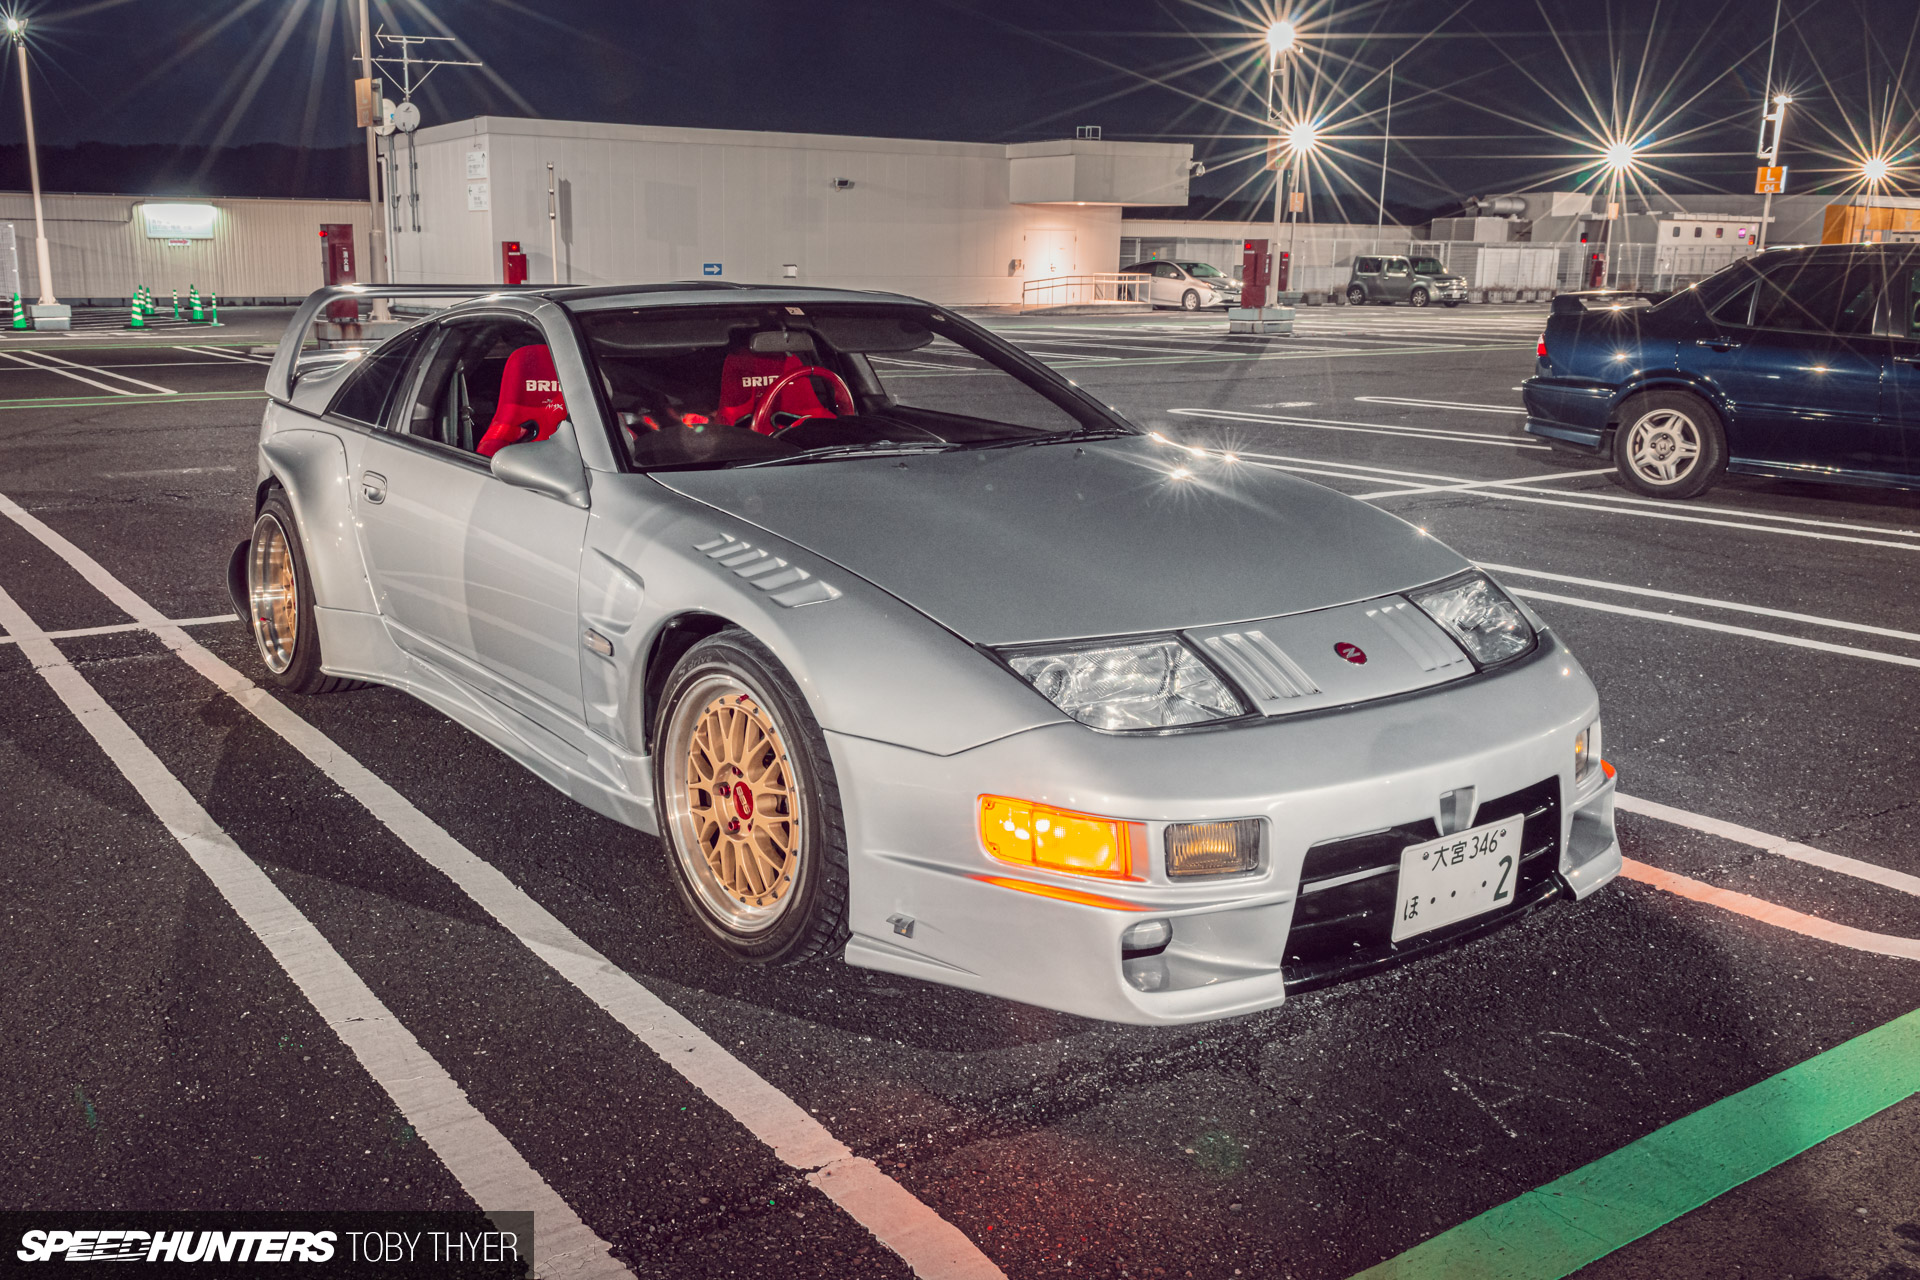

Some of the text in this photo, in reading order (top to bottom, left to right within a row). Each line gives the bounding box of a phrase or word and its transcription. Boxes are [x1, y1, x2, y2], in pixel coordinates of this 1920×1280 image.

[1766, 168, 1775, 181] L
[1764, 184, 1775, 192] 04
[735, 785, 750, 815] BBS
